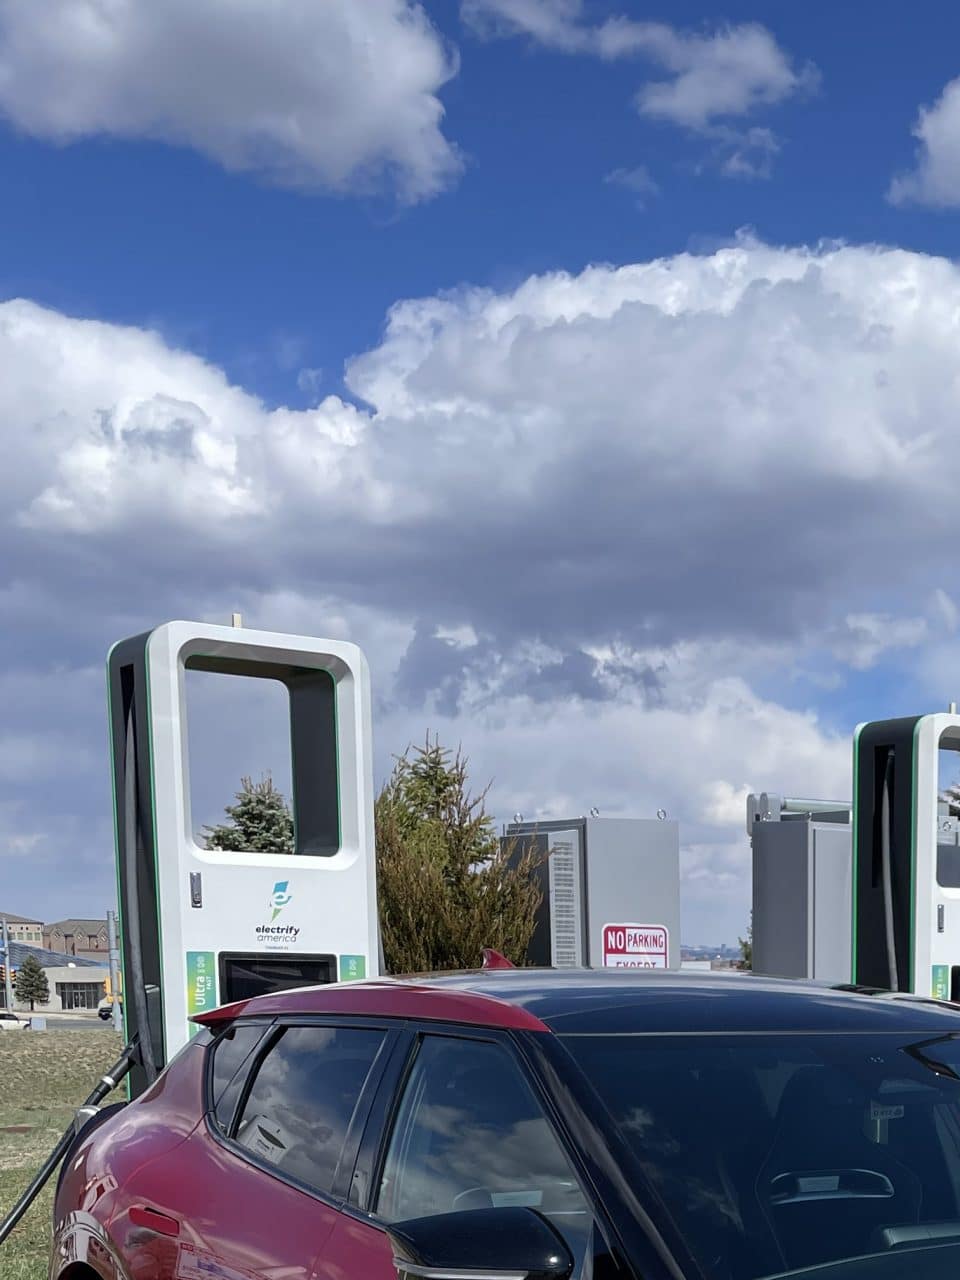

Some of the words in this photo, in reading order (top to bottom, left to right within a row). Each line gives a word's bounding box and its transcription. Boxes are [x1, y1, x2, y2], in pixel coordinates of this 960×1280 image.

[255, 925, 300, 936] electrify
[257, 935, 297, 943] america
[608, 931, 624, 949] NO
[627, 934, 663, 947] PARKING
[195, 976, 206, 1006] Ultra
